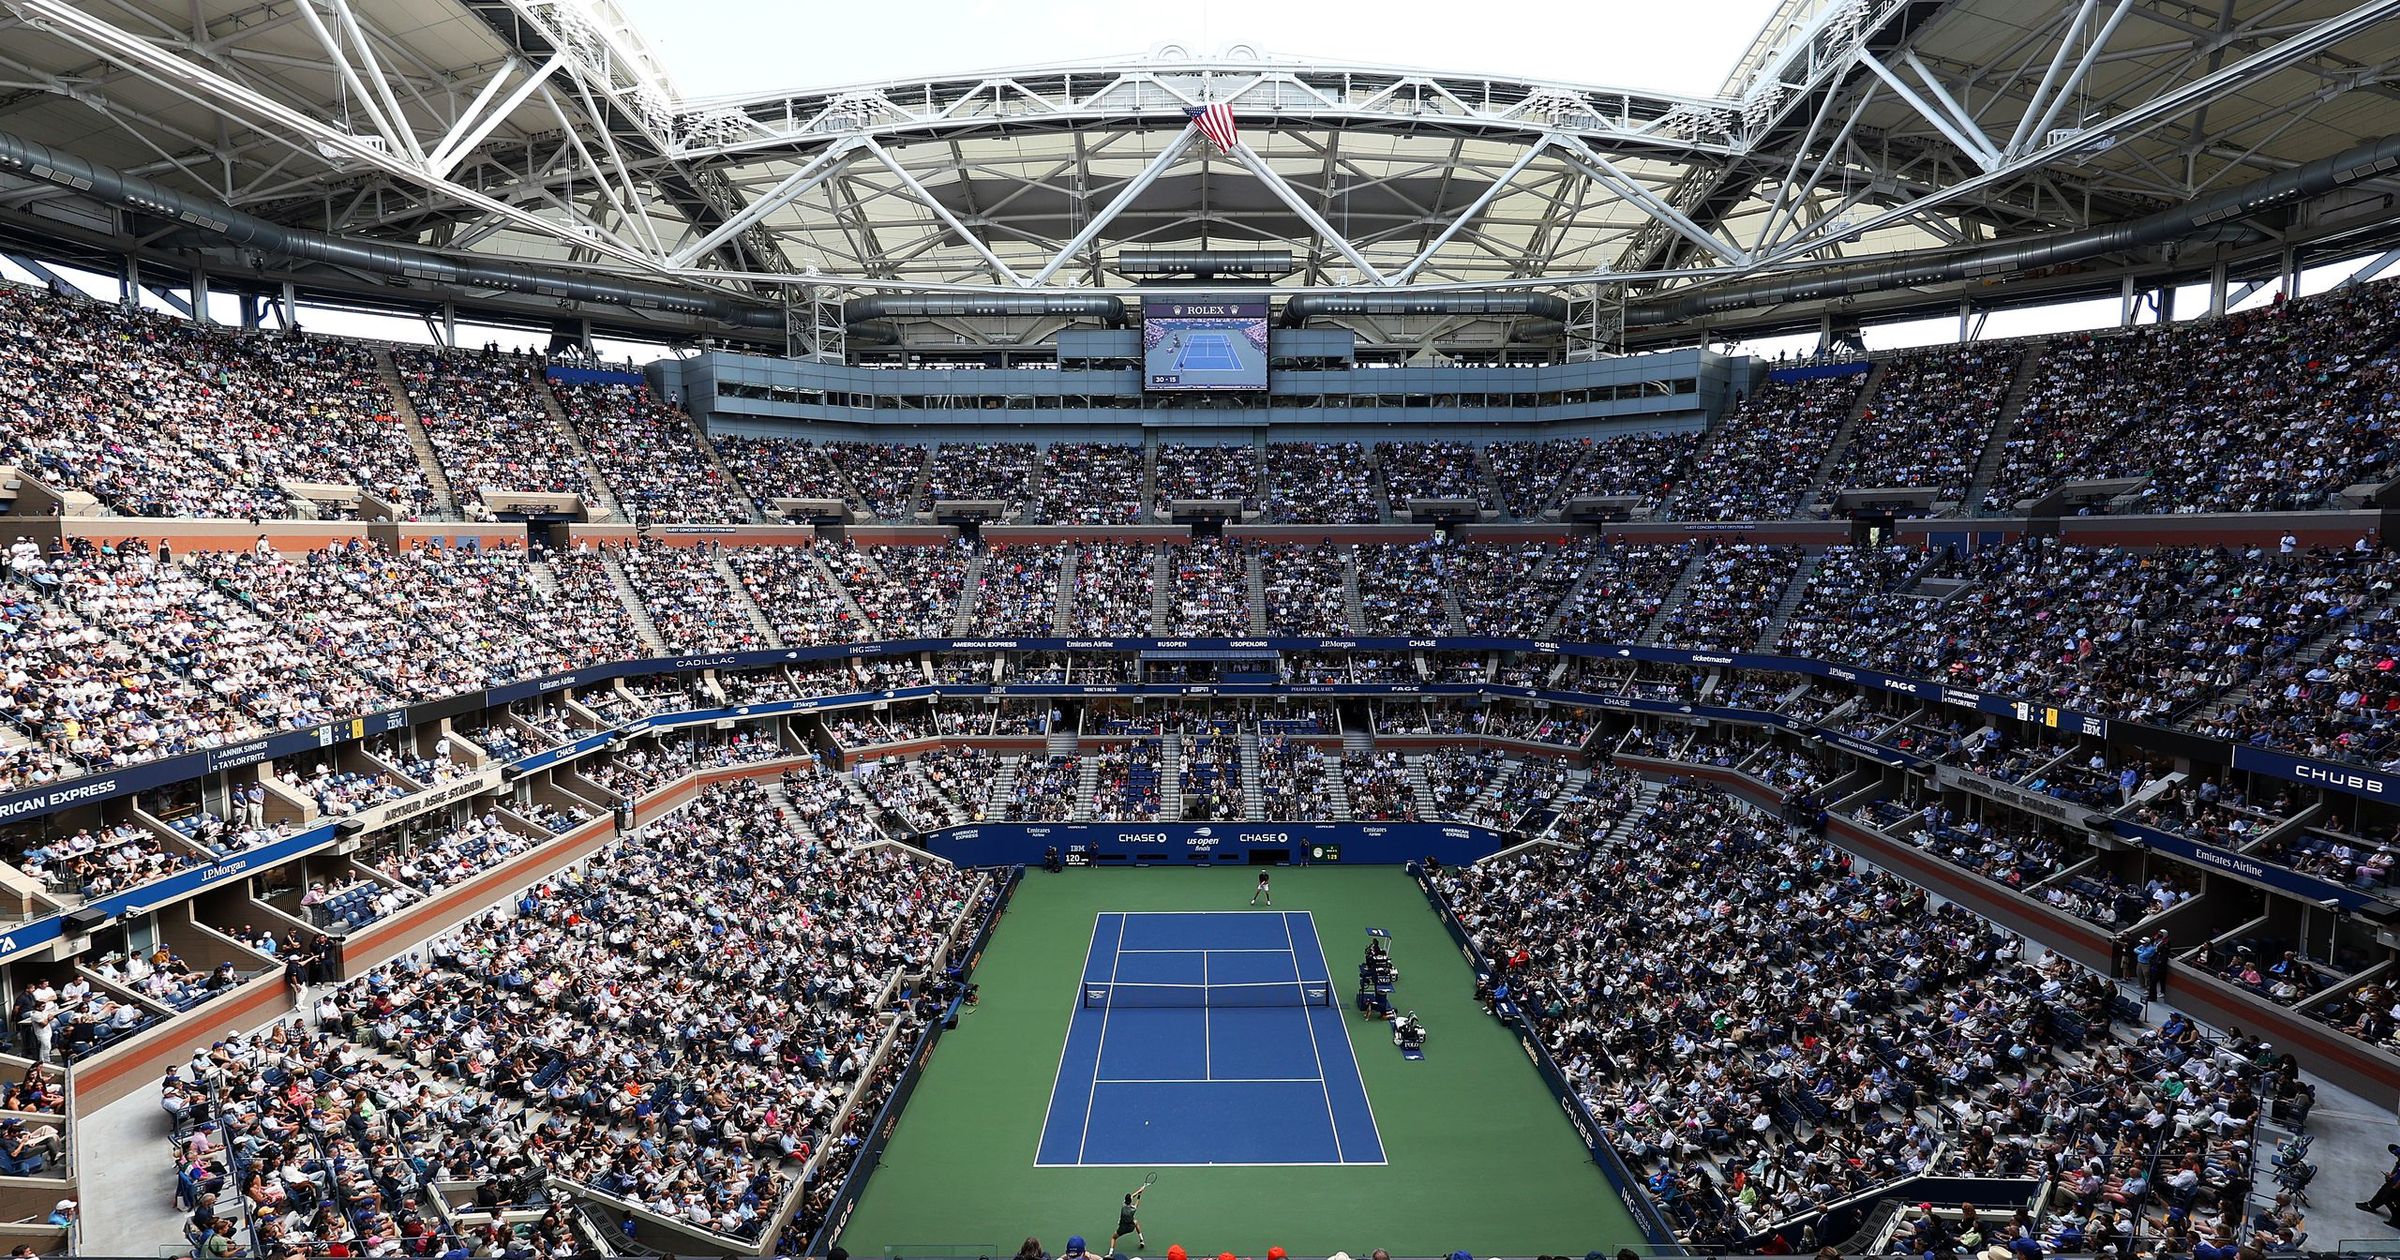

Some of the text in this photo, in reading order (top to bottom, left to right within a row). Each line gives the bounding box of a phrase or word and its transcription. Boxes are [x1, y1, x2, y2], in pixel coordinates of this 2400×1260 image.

[1187, 306, 1224, 314] ROLEX
[850, 646, 864, 654] IHG
[676, 656, 736, 668] CADILLAC
[1692, 654, 1732, 664] ticketmaster
[1828, 667, 1856, 680] J.P.Morgan
[1884, 680, 1916, 692] FAGE
[1604, 698, 1630, 707] CHASE
[387, 717, 403, 730] IBM
[2082, 723, 2101, 736] IBM
[218, 747, 244, 759] JANNIK
[244, 742, 268, 753] SINNER
[556, 744, 576, 758] CHASE
[218, 757, 246, 770] TAYLOR
[246, 752, 266, 763] FRITZ
[2296, 765, 2383, 793] CHUBB
[50, 780, 116, 806] EXPRESS
[383, 778, 484, 823] ARTHUR ASHE STADIUM
[1118, 834, 1156, 842] CHASE
[1197, 838, 1219, 846] open
[1240, 834, 1276, 842] CHASE
[1066, 854, 1080, 862] 120
[2196, 848, 2263, 878] Emirates Airline
[201, 859, 246, 882] J.P.Morgan
[1562, 1096, 1593, 1148] CHUBB
[1621, 1186, 1635, 1212] IHG
